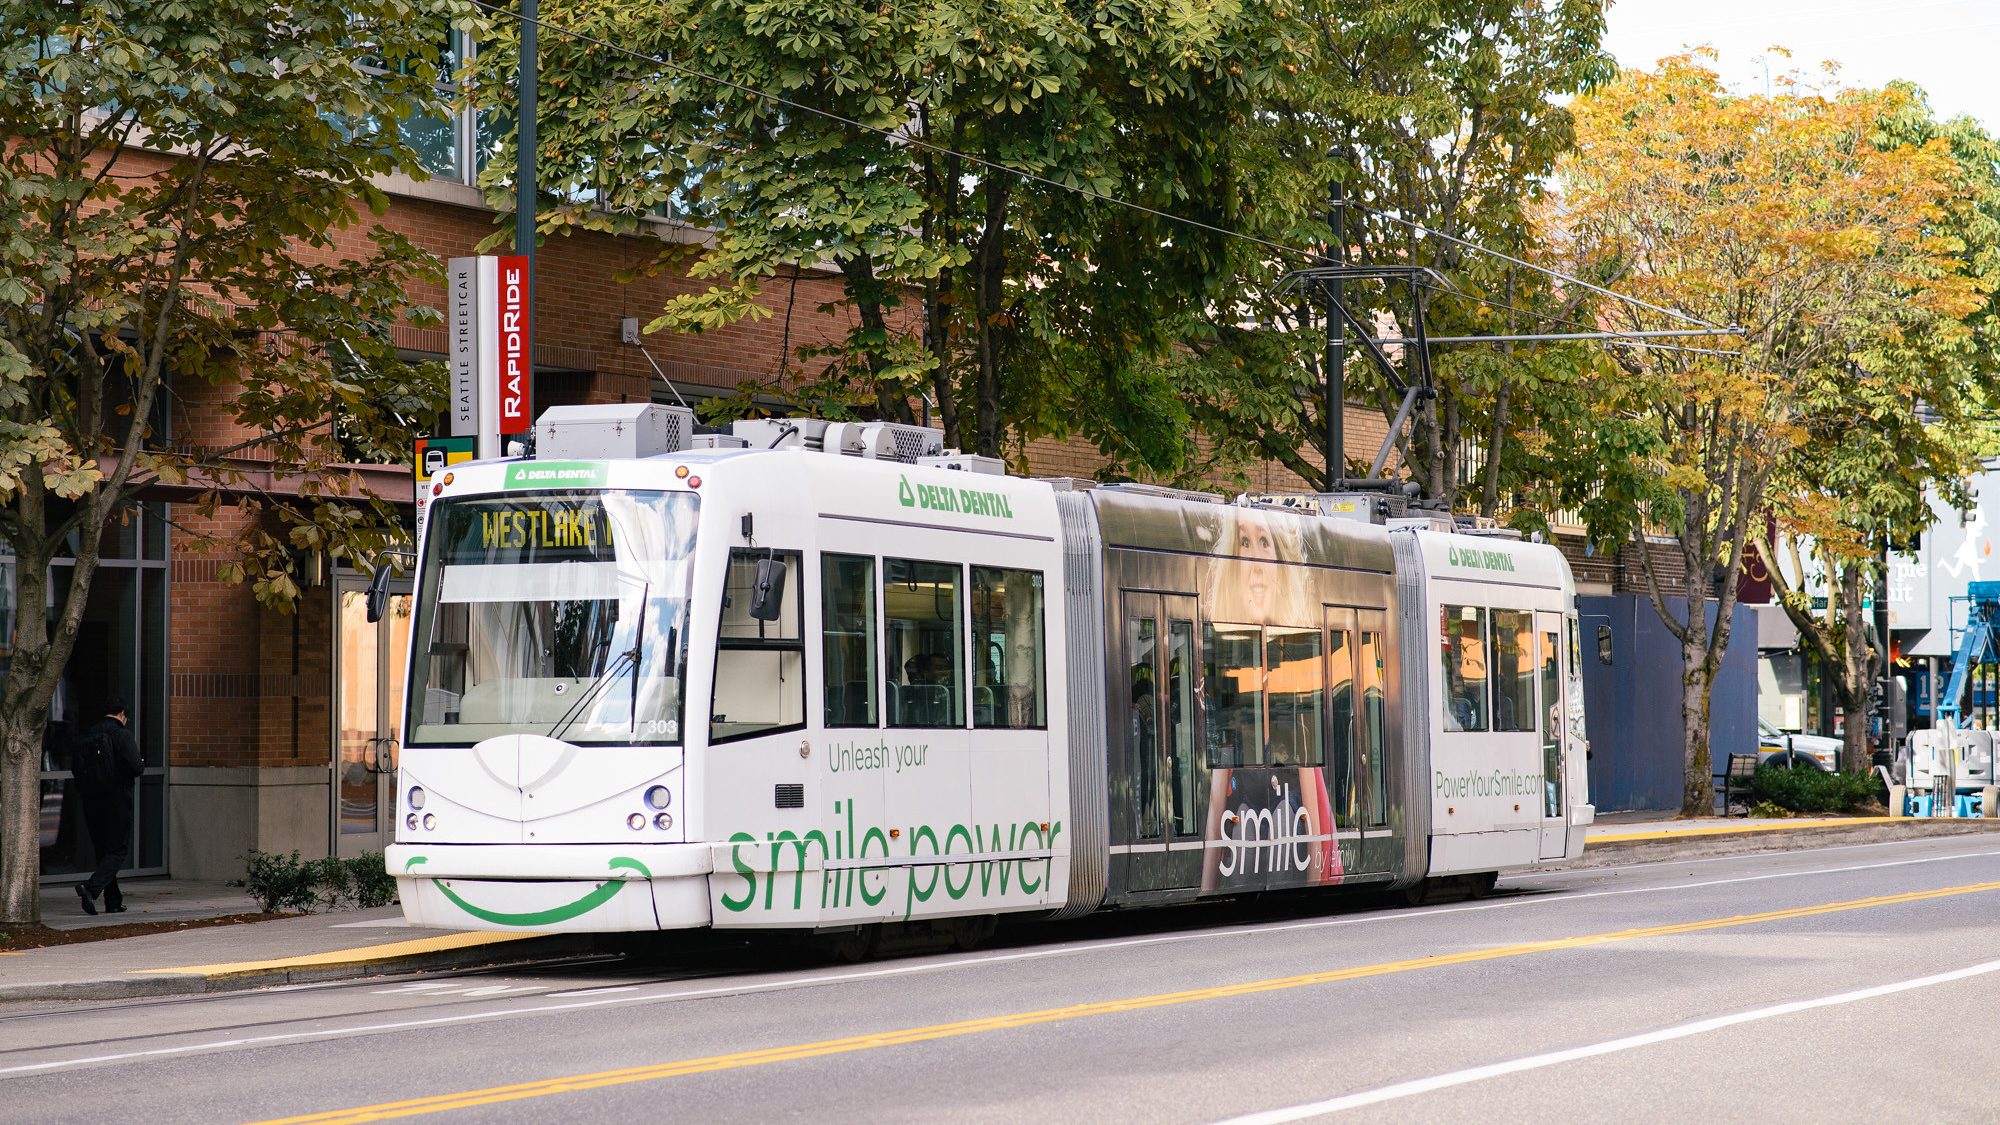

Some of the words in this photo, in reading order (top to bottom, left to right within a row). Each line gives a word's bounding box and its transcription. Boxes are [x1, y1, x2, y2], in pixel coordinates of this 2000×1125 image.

[458, 271, 468, 352] STREETCAR
[504, 268, 521, 418] RAPIDRIDE
[460, 361, 470, 421] SEATTLE
[528, 469, 556, 480] DELTA
[558, 469, 596, 480] DENTAL
[916, 483, 960, 512] DELTA
[959, 488, 1013, 518] DENTAL
[482, 509, 596, 549] WESTLAKE
[1458, 547, 1485, 569] DELTA
[1483, 550, 1515, 572] DENTAL
[1031, 575, 1043, 588] 303
[648, 720, 677, 734] 303
[828, 739, 890, 773] Unleash
[896, 743, 928, 774] your
[1218, 782, 1313, 877] smile
[720, 798, 890, 912] smile
[903, 820, 1061, 922] power
